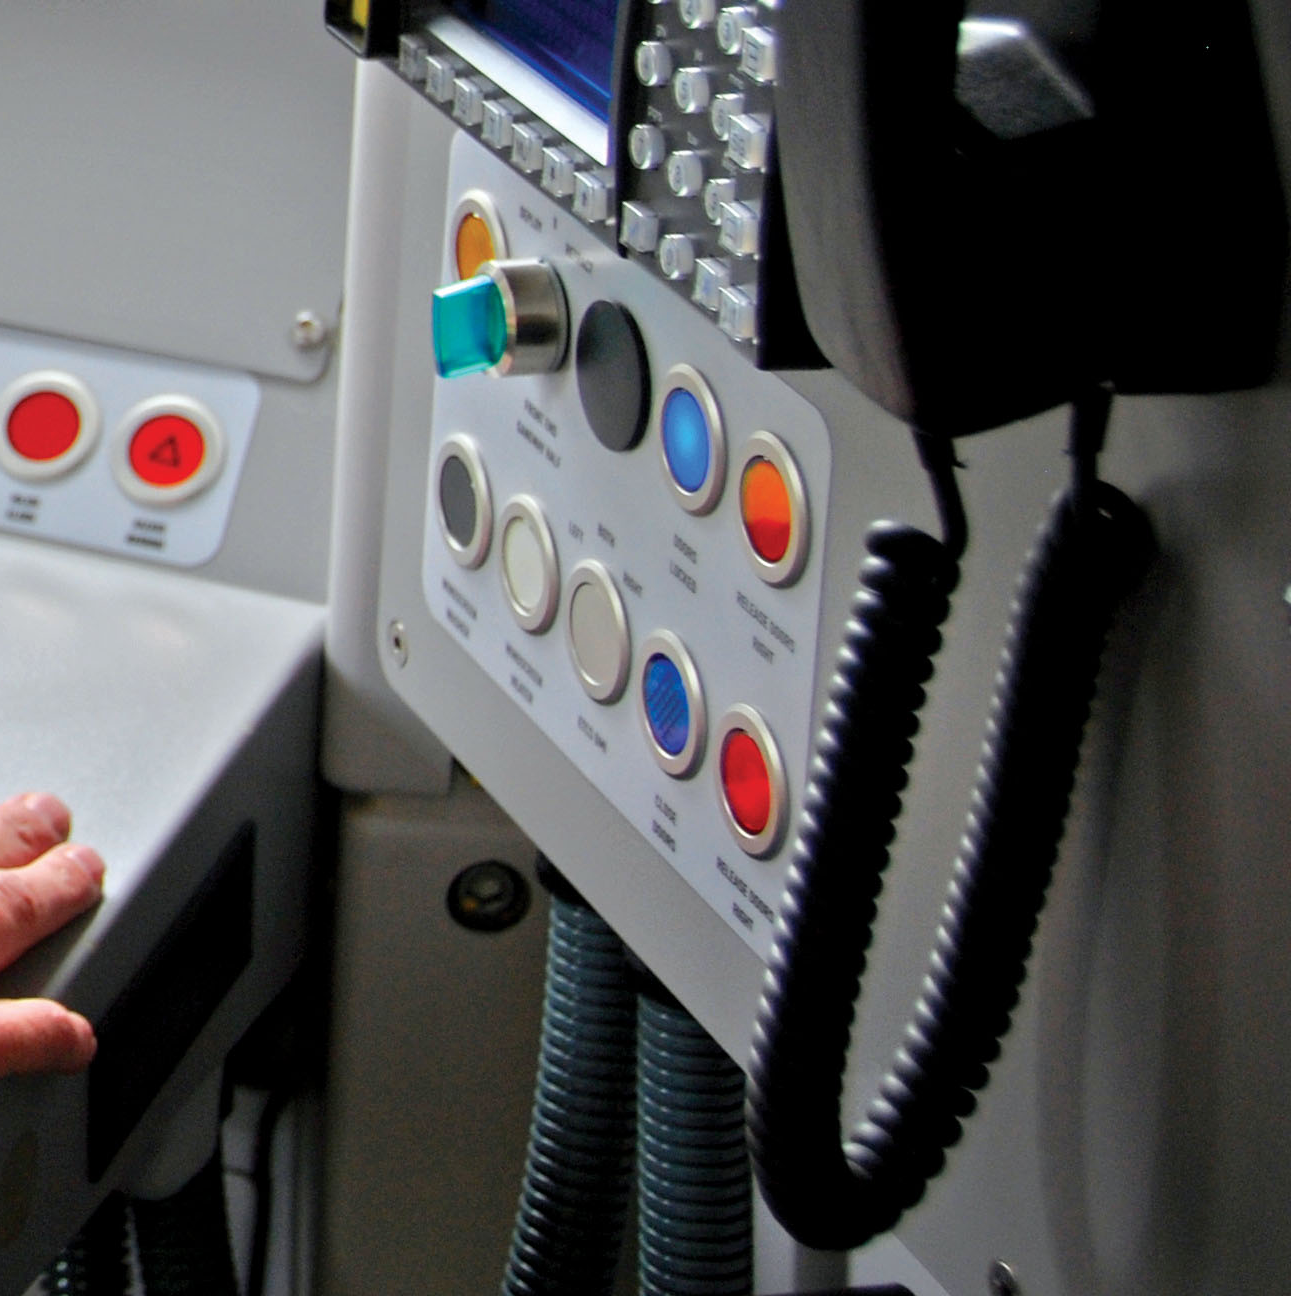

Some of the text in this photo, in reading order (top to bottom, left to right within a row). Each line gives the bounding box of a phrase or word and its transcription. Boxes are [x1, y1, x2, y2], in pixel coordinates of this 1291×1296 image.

[670, 560, 698, 594] LOCKED
[736, 590, 796, 655] RELEASE DOORS
[752, 634, 775, 665] RIGHT
[716, 856, 748, 898] RELEASE
[731, 901, 754, 932] RIGHT
